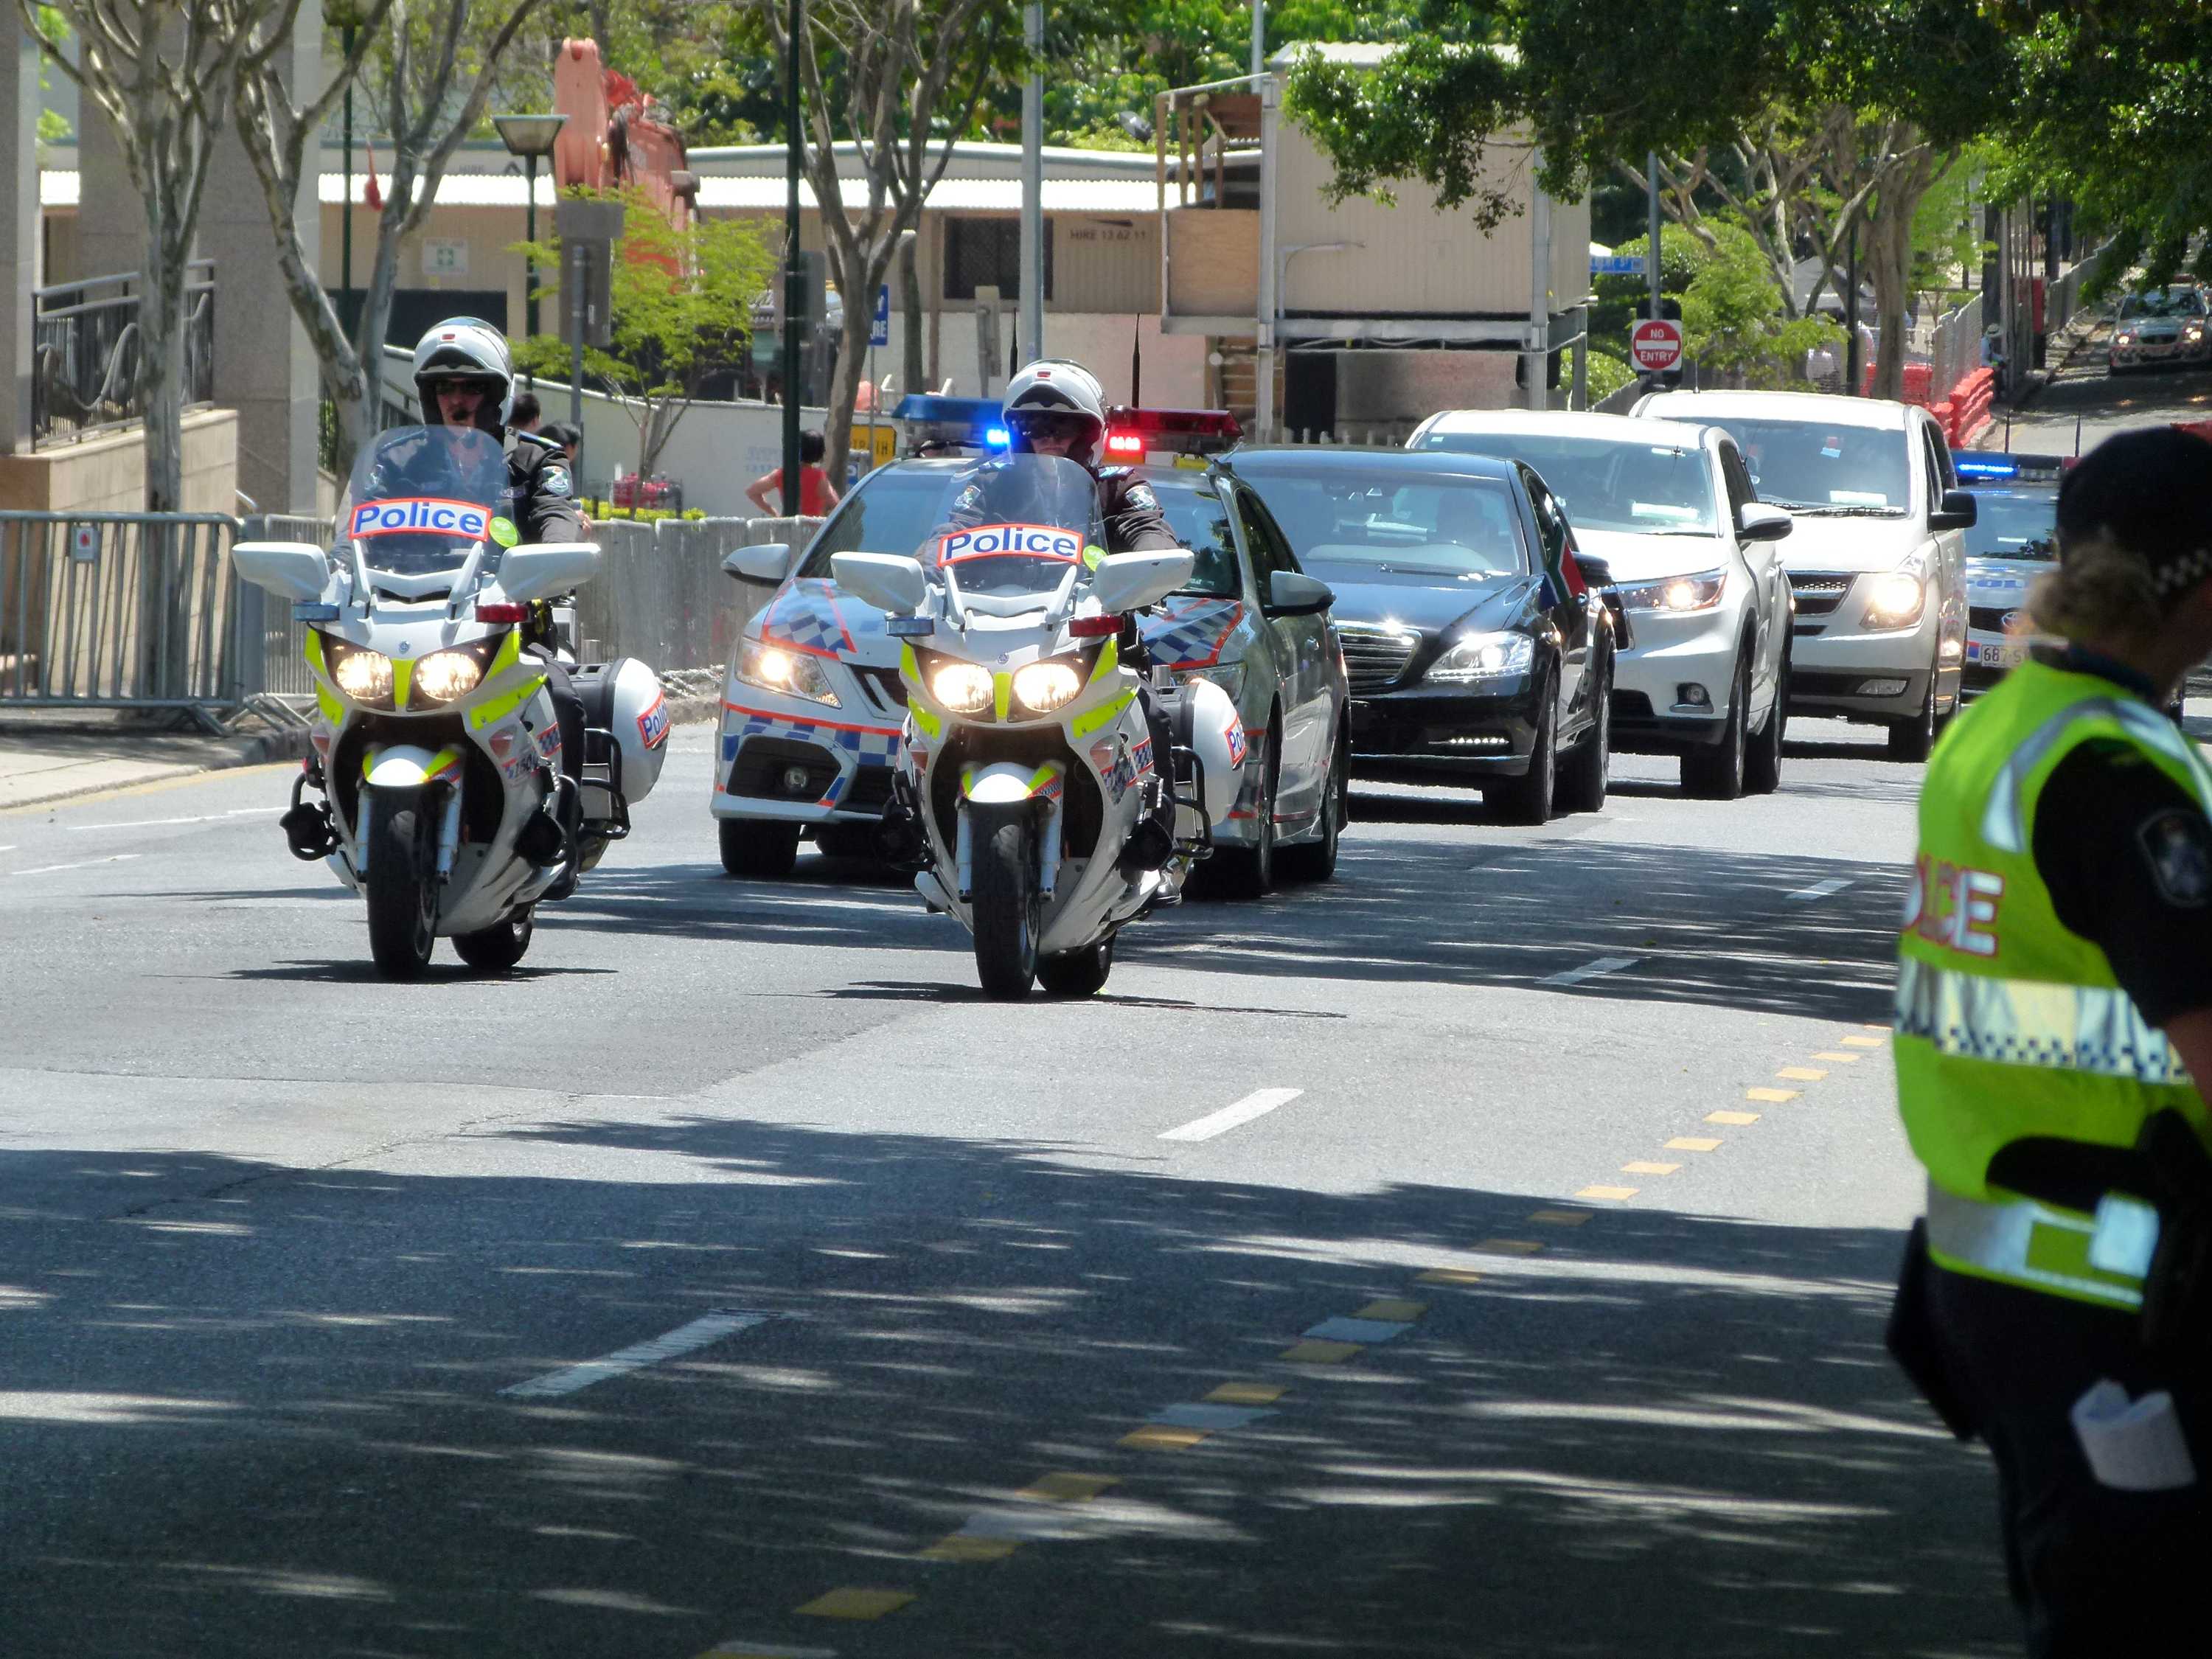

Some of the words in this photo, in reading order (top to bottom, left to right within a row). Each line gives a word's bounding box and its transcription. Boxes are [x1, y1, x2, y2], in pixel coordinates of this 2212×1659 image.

[1070, 229, 1096, 240] HIRE
[1650, 329, 1664, 338] NO
[1641, 351, 1674, 361] ENTRY
[354, 501, 483, 534] Police
[945, 527, 1076, 560] Police
